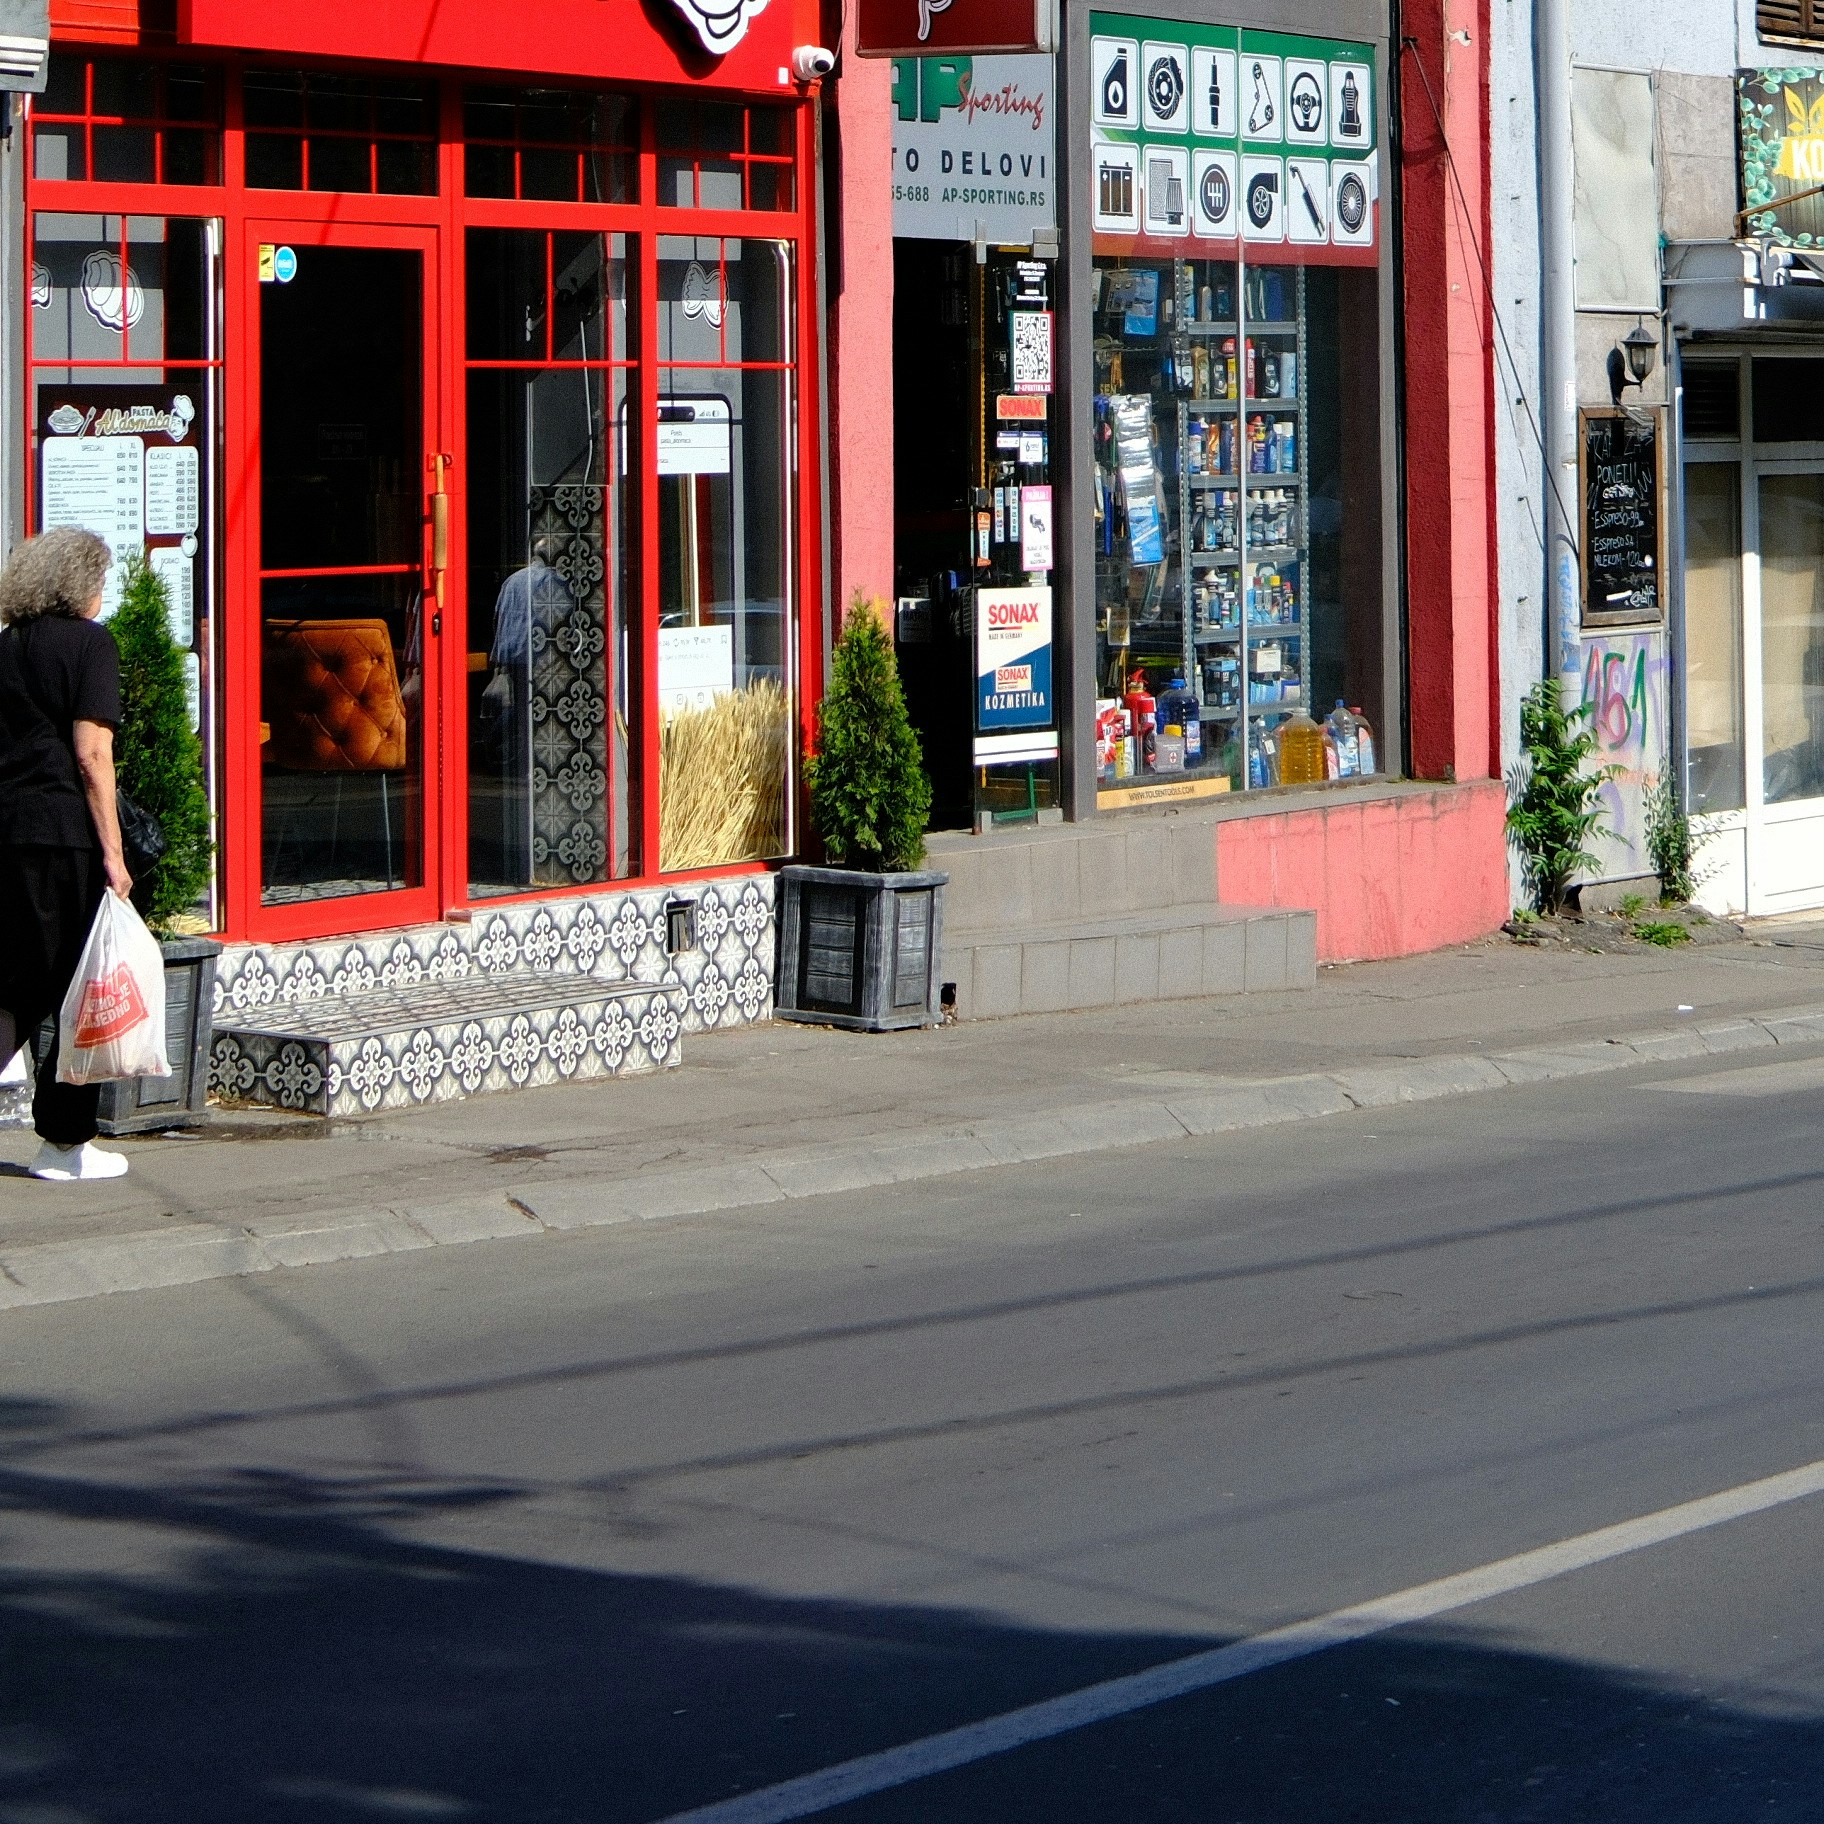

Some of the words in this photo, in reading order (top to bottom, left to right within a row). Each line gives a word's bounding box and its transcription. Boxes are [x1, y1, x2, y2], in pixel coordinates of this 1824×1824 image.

[958, 71, 1045, 130] Sporting
[941, 150, 1046, 179] DELOVI
[942, 187, 1046, 207] AP-SPORTING.RS
[999, 398, 1042, 417] SONAX
[988, 602, 1039, 626] SONAX
[997, 667, 1029, 681] SONAX
[985, 691, 1045, 711] KOZMETIKA
